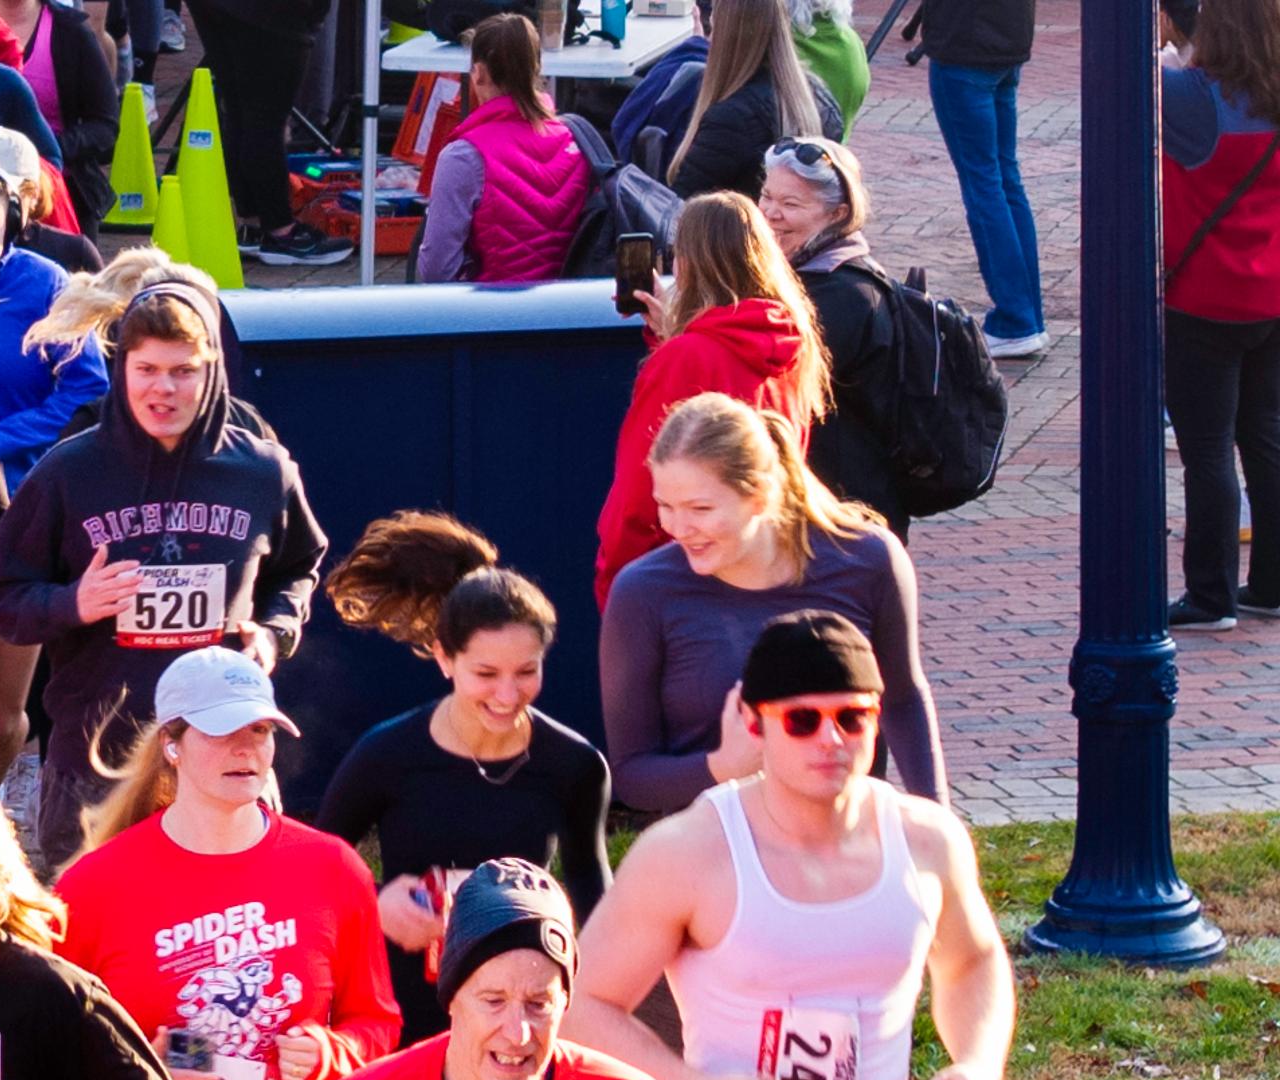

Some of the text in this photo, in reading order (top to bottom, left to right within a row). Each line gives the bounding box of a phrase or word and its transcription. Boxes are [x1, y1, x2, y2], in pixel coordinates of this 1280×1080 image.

[82, 501, 252, 549] RICHMOND
[156, 577, 190, 588] DASH
[134, 590, 208, 630] 520
[155, 636, 180, 646] MEAL
[182, 633, 212, 644] TICKET
[155, 901, 266, 958] SPIDER
[214, 917, 298, 966] DASH
